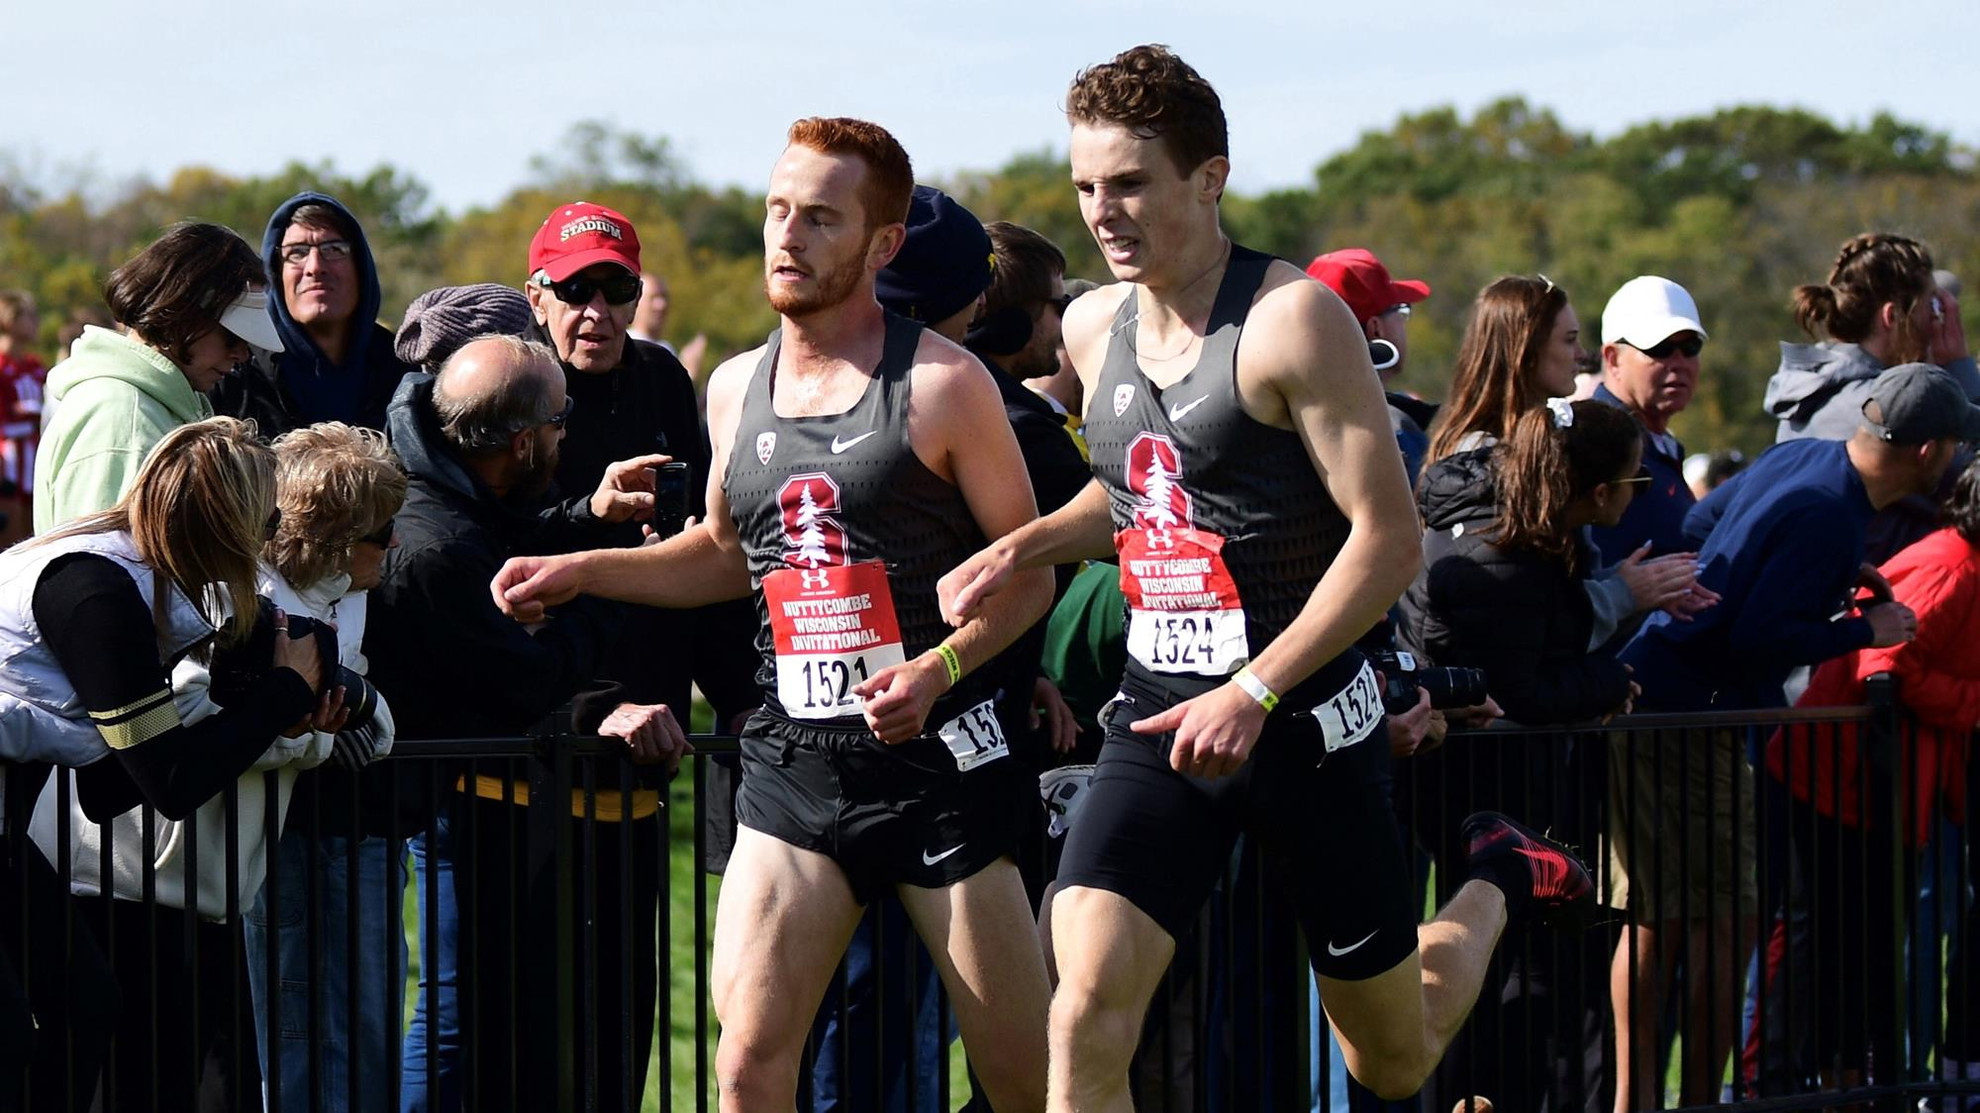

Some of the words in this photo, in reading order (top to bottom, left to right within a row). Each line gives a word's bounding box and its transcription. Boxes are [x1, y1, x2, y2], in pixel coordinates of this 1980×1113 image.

[560, 220, 622, 242] STADIUM
[1130, 558, 1211, 576] NUTTYCOMBE
[1138, 575, 1204, 593] WISCONSIN
[782, 594, 872, 617] NUTTYCOMBE
[1141, 592, 1222, 609] INVITATIONAL
[793, 614, 861, 633] WISCONSIN
[791, 628, 881, 650] INVITATIONAL
[1152, 617, 1214, 664] 1524
[1332, 666, 1378, 739] 1524
